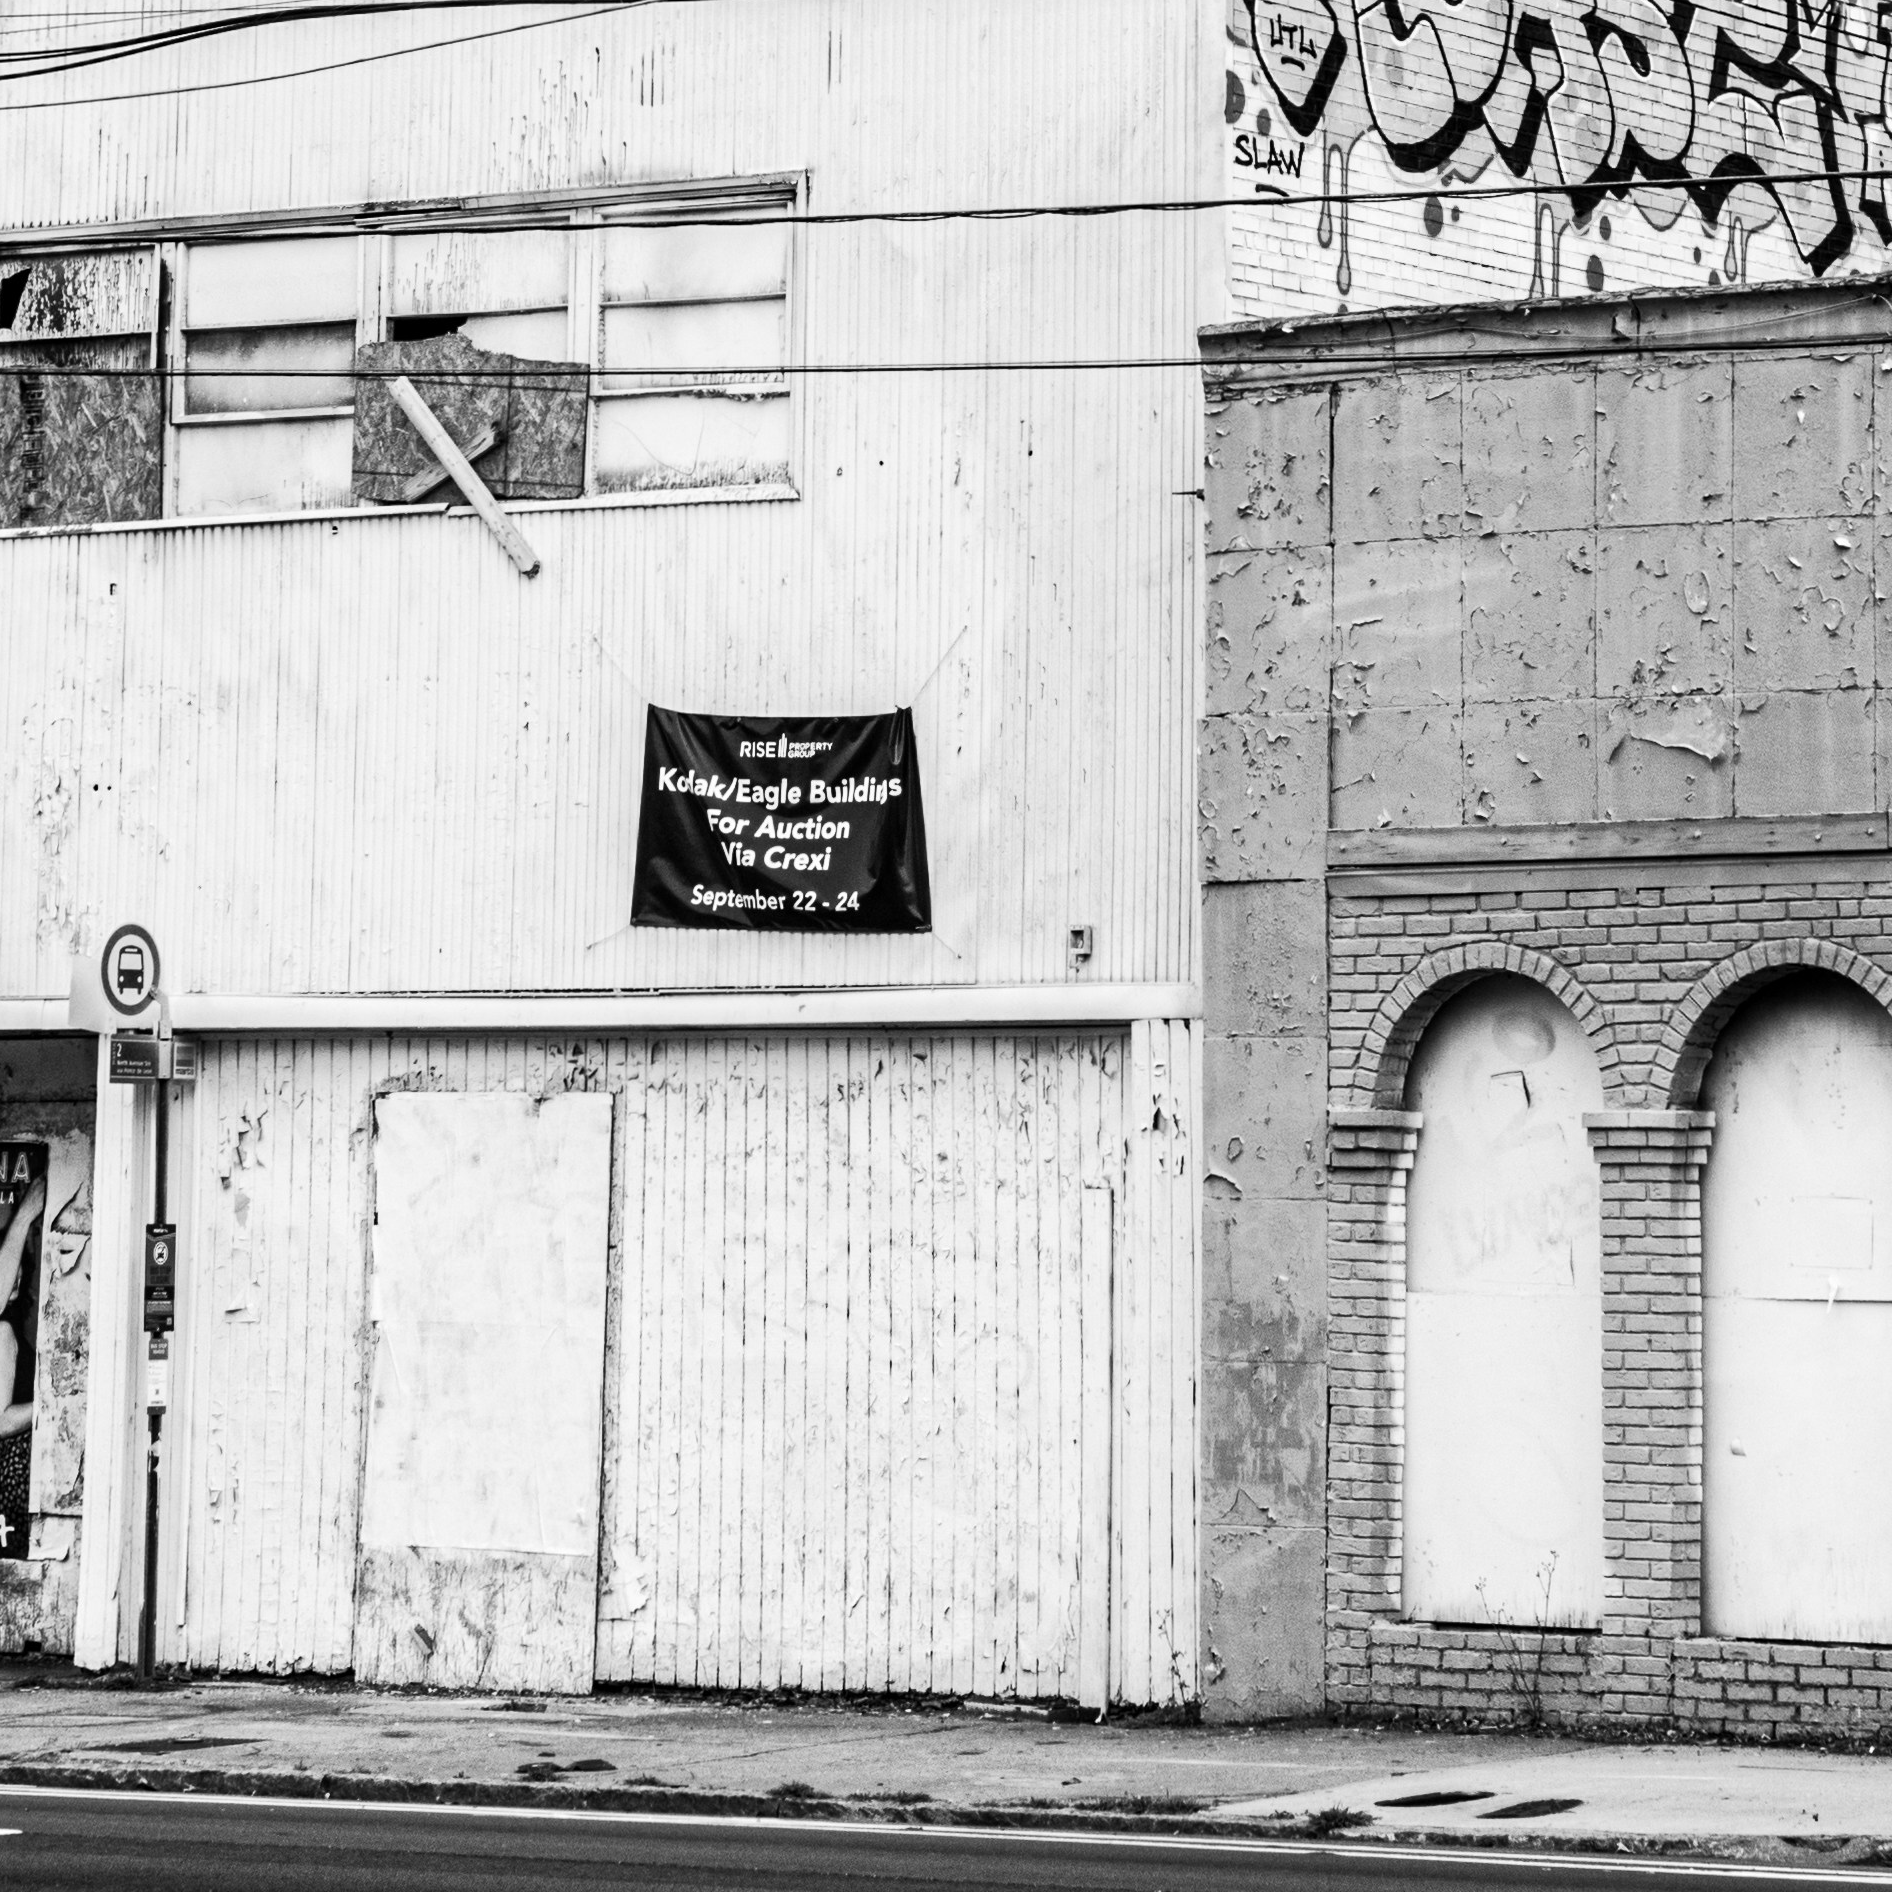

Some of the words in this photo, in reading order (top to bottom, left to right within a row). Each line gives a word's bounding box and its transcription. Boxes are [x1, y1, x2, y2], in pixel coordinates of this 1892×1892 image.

[1235, 134, 1305, 178] SLAW
[740, 741, 776, 758] RISE
[787, 749, 816, 759] GROUP
[789, 741, 833, 751] PROPERTY
[707, 808, 749, 836] For
[755, 815, 850, 840] Auction
[720, 841, 755, 867] Via
[764, 846, 832, 871] Crexi
[692, 884, 785, 912] September
[792, 890, 816, 911] 22
[835, 891, 860, 912] 24
[116, 1043, 122, 1057] 2
